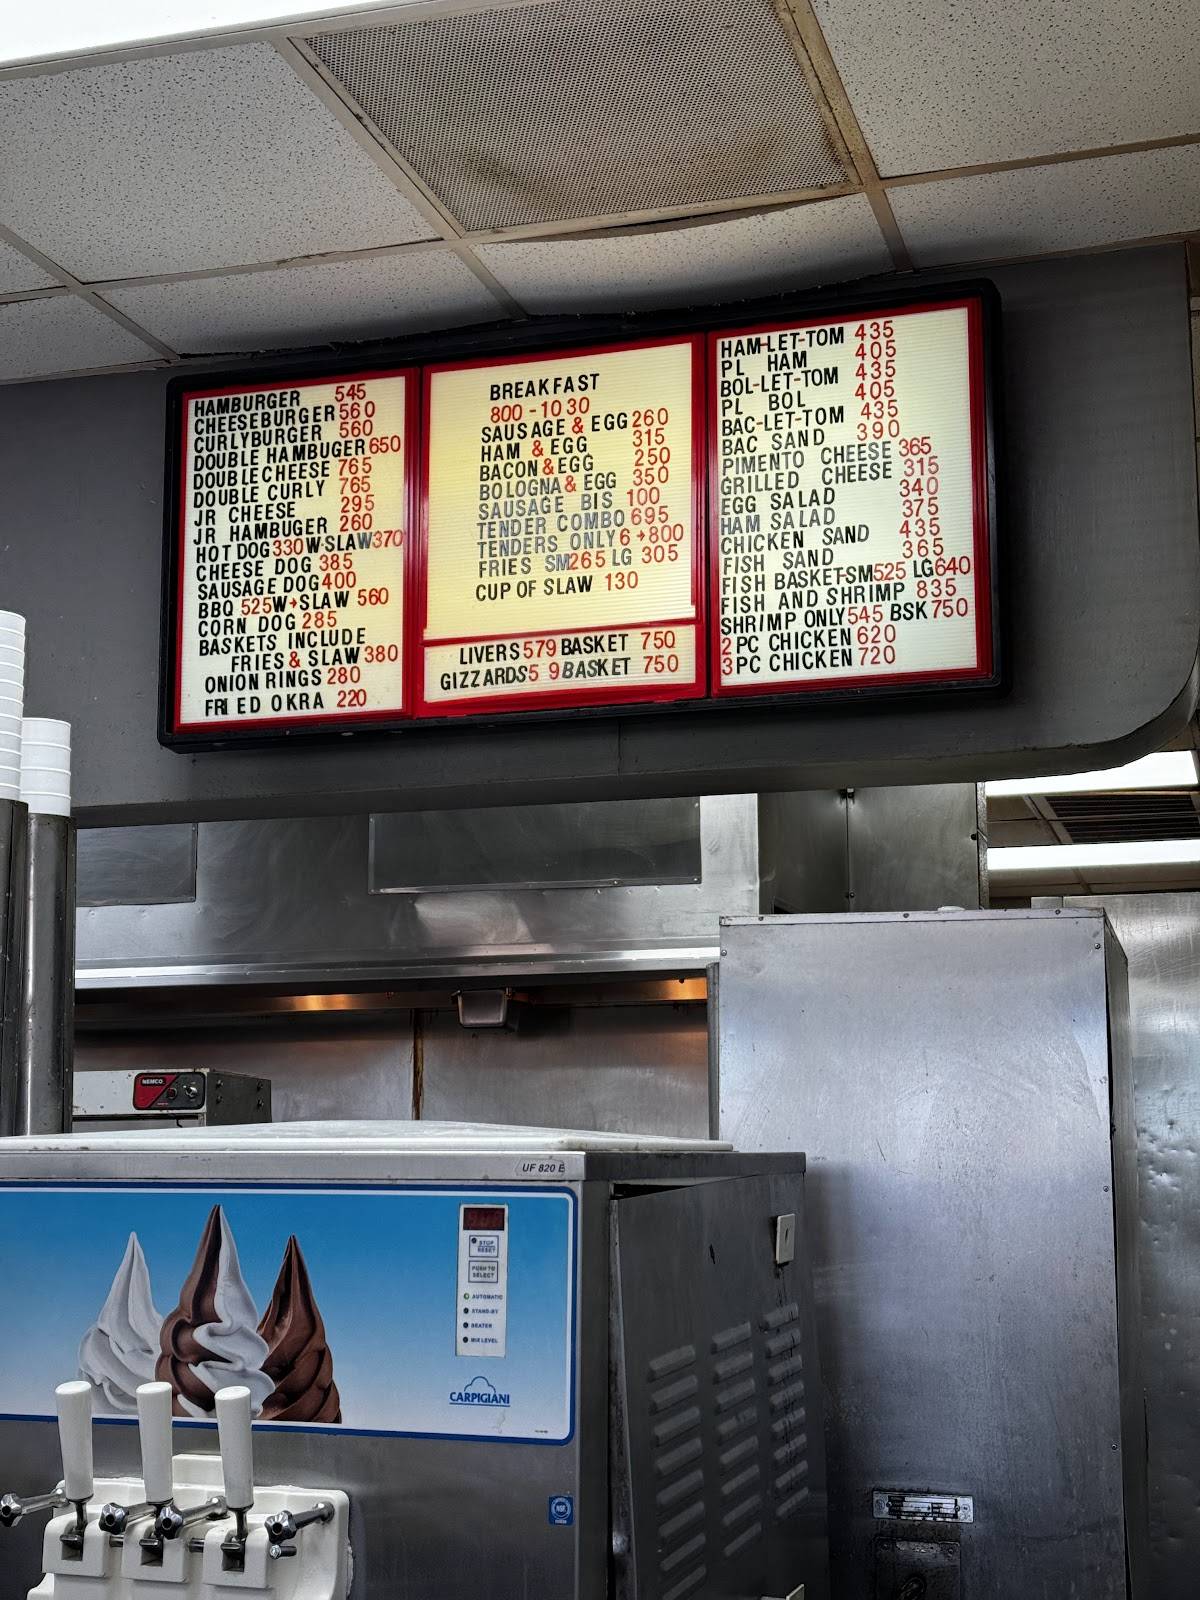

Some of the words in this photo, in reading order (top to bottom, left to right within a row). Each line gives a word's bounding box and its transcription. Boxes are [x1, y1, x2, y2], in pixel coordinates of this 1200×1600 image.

[855, 320, 894, 341] 435
[722, 360, 744, 377] PL
[768, 351, 807, 372] HAM
[856, 340, 896, 360] 405
[856, 360, 896, 380] 435
[195, 390, 300, 417] HAMBURGER
[335, 384, 366, 402] 545
[491, 374, 599, 400] BREAKFAST
[722, 398, 742, 417] PL
[769, 391, 805, 411] BOL
[855, 381, 894, 400] 405
[194, 405, 334, 435] CHEESEBURGER
[340, 401, 375, 420] 560
[482, 419, 565, 443] SAUSAGE
[592, 413, 627, 432] EGG
[632, 408, 669, 428] 260
[861, 400, 898, 421] 435
[194, 425, 321, 453] CURLYBURGER
[340, 420, 373, 438] 560
[194, 450, 259, 471] DOUBLE
[267, 439, 365, 464] HAMBUGER
[369, 435, 400, 453] 650
[482, 443, 520, 462] HAM
[551, 436, 587, 455] EGG
[633, 428, 664, 447] 315
[723, 436, 757, 456] BAC
[772, 429, 824, 451] SAND
[857, 419, 899, 441] 390
[480, 460, 537, 482] BACON
[558, 455, 593, 473] EGG
[634, 447, 670, 467] 250
[723, 451, 804, 476] PIMENTO
[821, 441, 891, 465] CHEESE
[899, 437, 931, 457] 365
[194, 469, 258, 490] DOUBLE
[262, 461, 330, 483] CHEESE
[339, 457, 372, 476] 765
[480, 477, 561, 500] BOLOGNA
[584, 472, 616, 491] EGG
[633, 467, 669, 486] 350
[721, 471, 799, 495] GRILLED
[822, 462, 892, 485] CHEESE
[904, 456, 939, 477] 315
[194, 487, 259, 508] DOUBLE
[268, 480, 325, 501] CURLY
[339, 476, 370, 494] 765
[479, 496, 564, 520] SAUSAGE
[581, 492, 613, 510] BIS
[627, 487, 660, 506] 100
[722, 496, 756, 515] EGG
[771, 488, 835, 511] SALAD
[899, 477, 938, 497] 340
[194, 509, 215, 526] JR
[229, 502, 295, 523] CHEESE
[341, 494, 374, 513] 295
[477, 517, 546, 540] TENDER
[557, 510, 625, 532] COMBO
[631, 506, 669, 525] 695
[721, 514, 760, 535] HAM
[771, 508, 835, 530] SALAD
[903, 497, 938, 518] 375
[194, 528, 215, 545] JR
[230, 516, 327, 542] HAMBUGER
[340, 514, 372, 532] 260
[197, 544, 231, 563] HOT
[237, 542, 270, 558] DOG
[273, 539, 303, 557] 330
[373, 529, 403, 548] 370
[478, 535, 558, 558] TENDERS
[570, 530, 615, 551] ONLY
[721, 531, 804, 555] CHICKEN
[822, 524, 869, 546] SAND
[900, 517, 939, 538] 435
[197, 561, 263, 581] CHEESE
[275, 557, 311, 575] DOG
[320, 553, 352, 572] 385
[479, 557, 531, 578] FRIES
[545, 554, 569, 572] SM
[569, 551, 606, 570] 265
[612, 548, 632, 566] LG
[642, 544, 678, 564] 305
[724, 555, 764, 575] FISH
[783, 548, 833, 569] SAND
[903, 538, 943, 559] 365
[198, 578, 276, 600] SAUSAGE
[284, 575, 319, 593] DOG
[322, 571, 356, 590] 400
[476, 583, 511, 601] CUP
[517, 580, 536, 599] OF
[544, 575, 592, 596] SLAW
[605, 571, 638, 591] 130
[723, 575, 765, 595] FISH
[874, 561, 906, 581] 525
[914, 559, 933, 578] LG
[935, 556, 970, 577] 640
[199, 601, 233, 619] BBQ
[242, 598, 272, 616] 525
[300, 591, 349, 611] SLAW
[358, 588, 389, 606] 560
[721, 594, 764, 615] FISH
[779, 590, 818, 610] AND
[826, 583, 904, 606] SHRIMP
[917, 578, 956, 598] 835
[199, 618, 246, 638] CORN
[259, 614, 296, 633] DOG
[302, 611, 337, 629] 285
[721, 612, 796, 635] SHRIMP
[804, 607, 845, 628] ONLY
[848, 605, 883, 625] 545
[891, 601, 927, 621] BSK
[932, 598, 968, 618] 750
[200, 635, 276, 656] BASKETS
[289, 628, 365, 650] INCLUDE
[460, 643, 520, 665] LIVERS
[523, 639, 556, 659] 579
[561, 634, 628, 656] BASKET
[641, 631, 675, 649] 750
[737, 635, 759, 654] PC
[769, 628, 850, 652] CHICKEN
[857, 624, 896, 645] 620
[232, 653, 284, 672] FRIES
[309, 647, 360, 666] SLAW
[365, 644, 398, 663] 380
[441, 666, 527, 690] GIZZARDS
[562, 657, 630, 678] BASKET
[644, 655, 678, 674] 750
[737, 655, 761, 674] PC
[769, 648, 852, 672] CHICKEN
[859, 646, 895, 666] 720
[205, 673, 258, 694] ONION
[266, 669, 322, 689] RINGS
[328, 666, 361, 685] 280
[272, 692, 323, 712] OKRA
[337, 689, 367, 708] 220
[450, 1392, 510, 1404] CARPIGIANI
